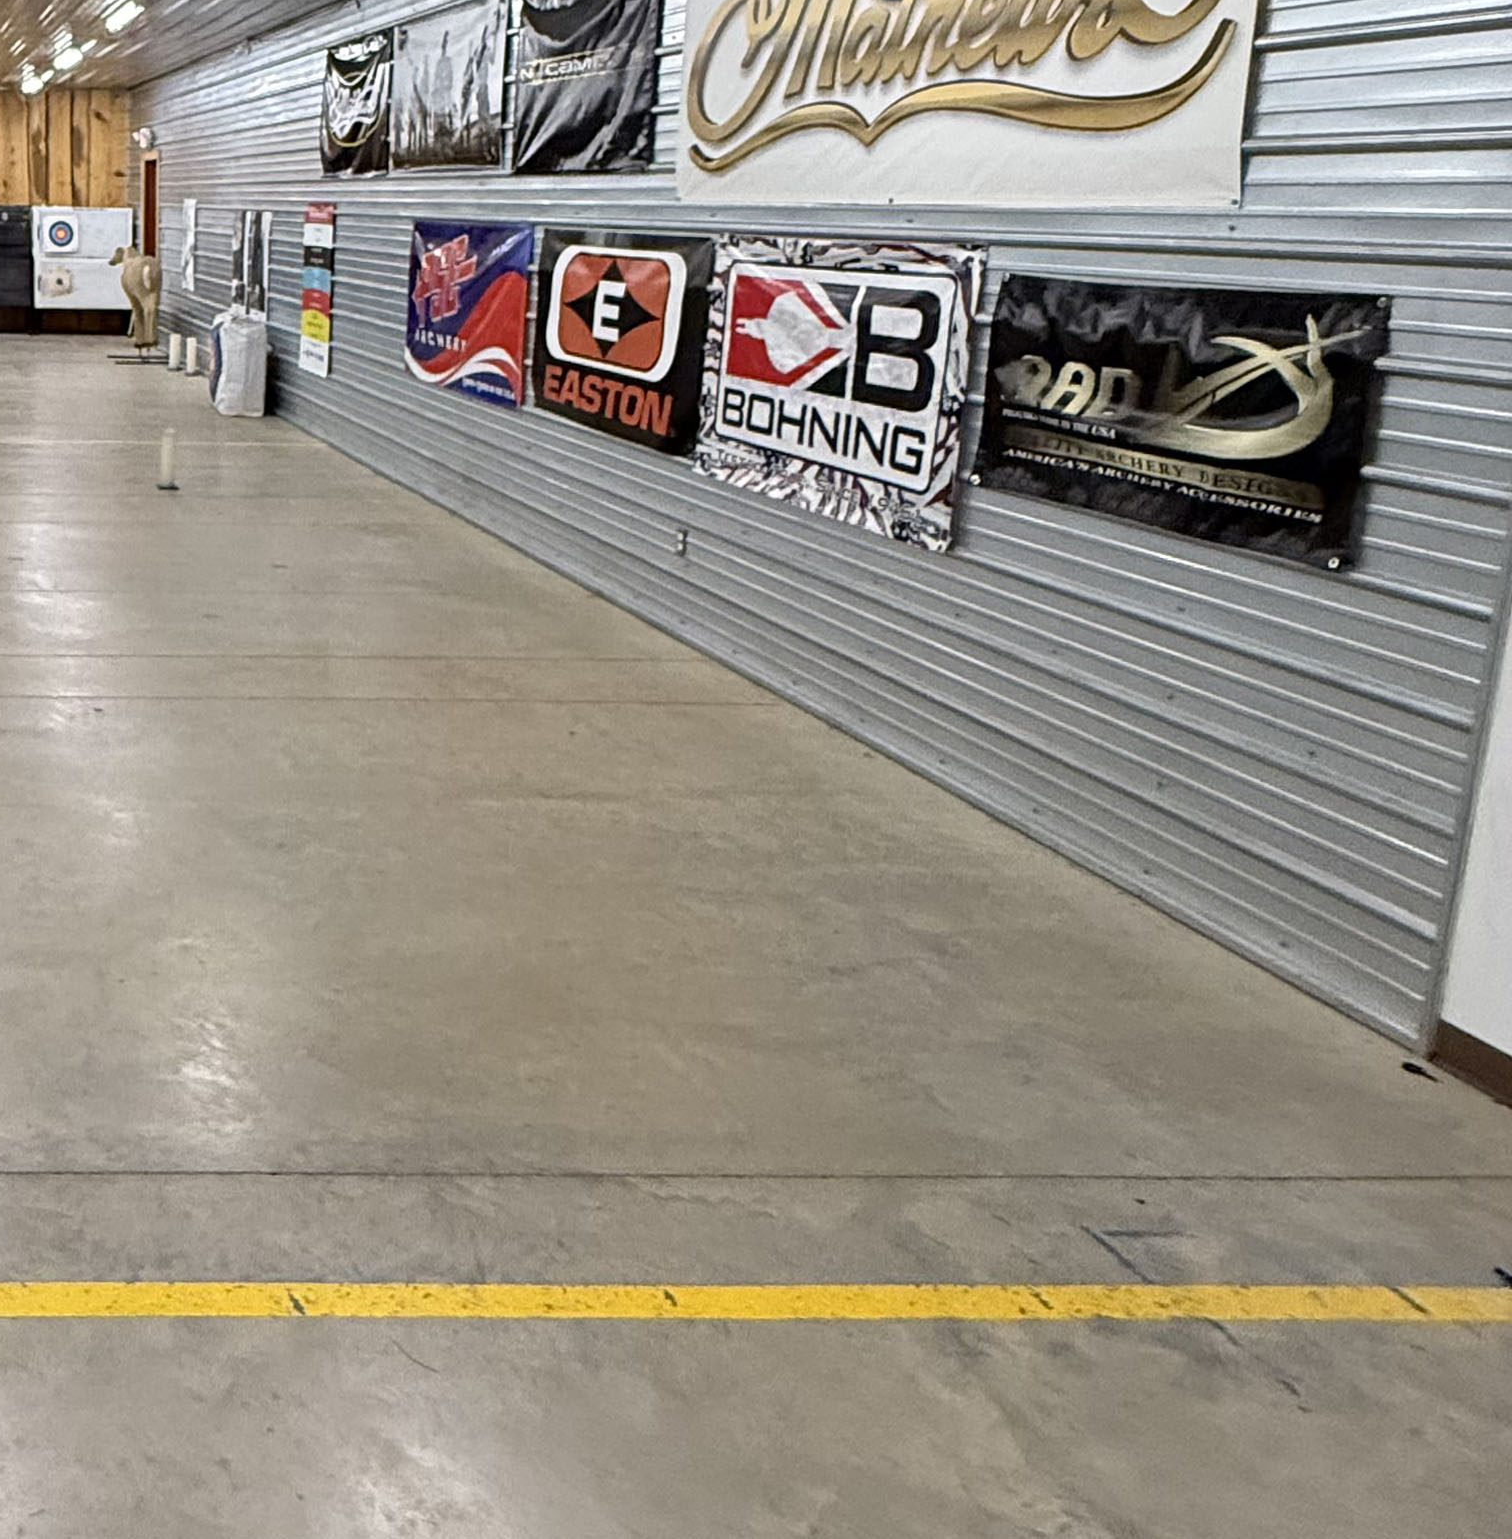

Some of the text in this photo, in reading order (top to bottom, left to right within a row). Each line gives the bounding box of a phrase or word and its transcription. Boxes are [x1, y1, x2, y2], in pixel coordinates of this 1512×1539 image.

[414, 329, 467, 352] ARCHERY
[592, 281, 626, 342] E
[851, 286, 940, 412] B
[543, 365, 672, 436] EASTON
[722, 388, 926, 477] BOHNING
